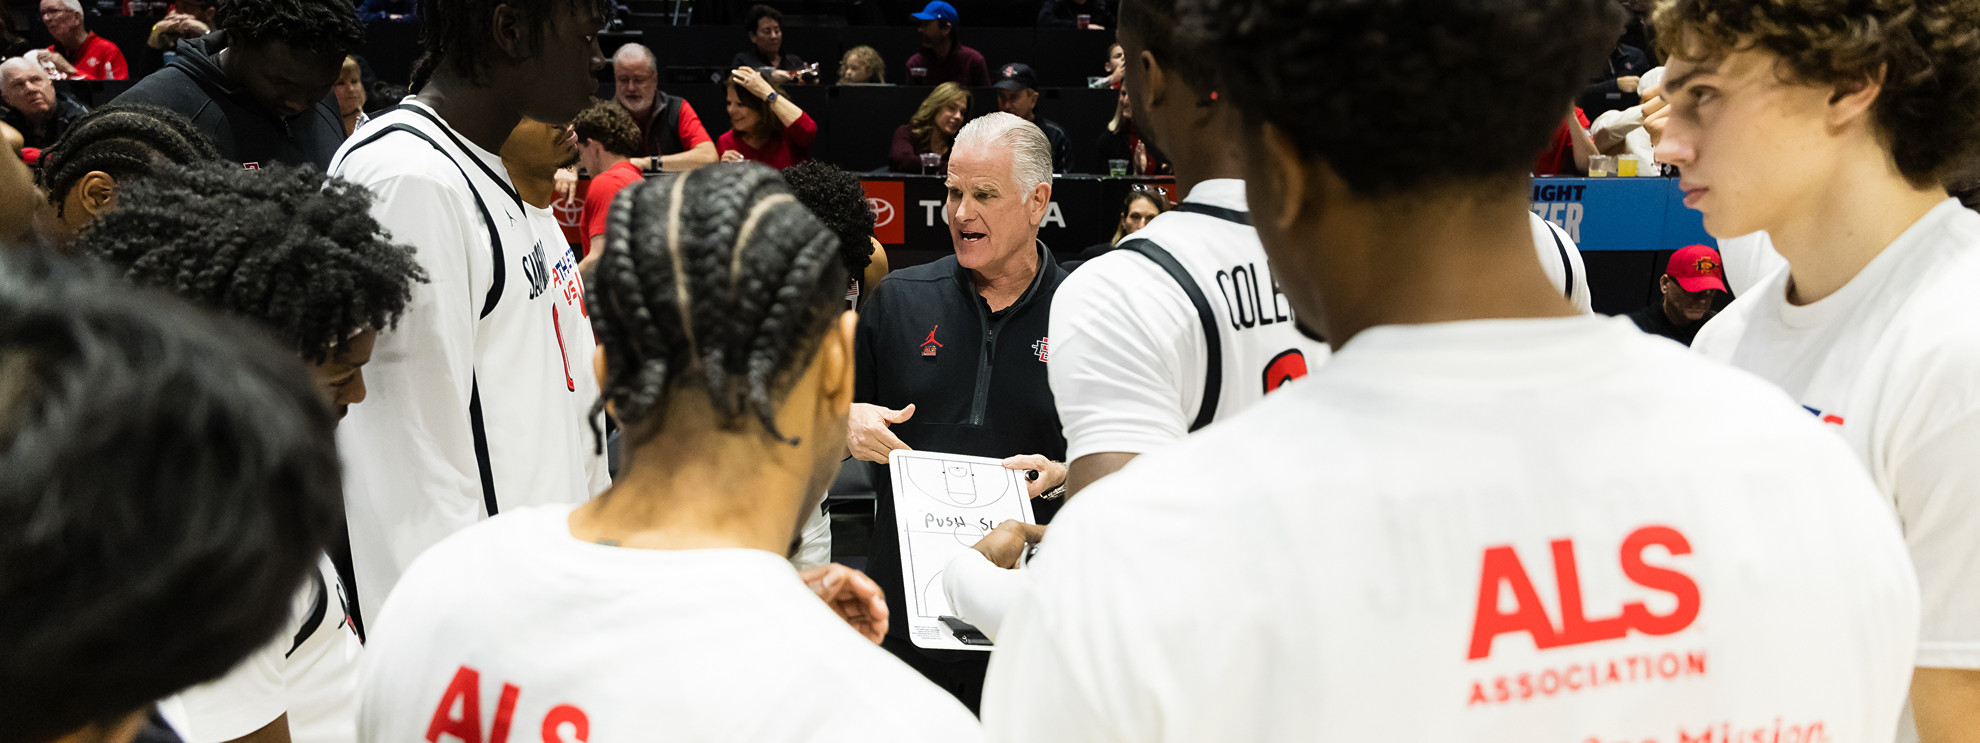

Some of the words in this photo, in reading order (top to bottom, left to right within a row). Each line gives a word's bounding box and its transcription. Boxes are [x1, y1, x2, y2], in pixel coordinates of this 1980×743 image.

[1533, 185, 1587, 201] IGHT
[1216, 262, 1294, 331] COLE
[924, 512, 966, 528] PUSH
[1466, 524, 1701, 661] ALS
[1467, 650, 1707, 707] ASSOCIATION
